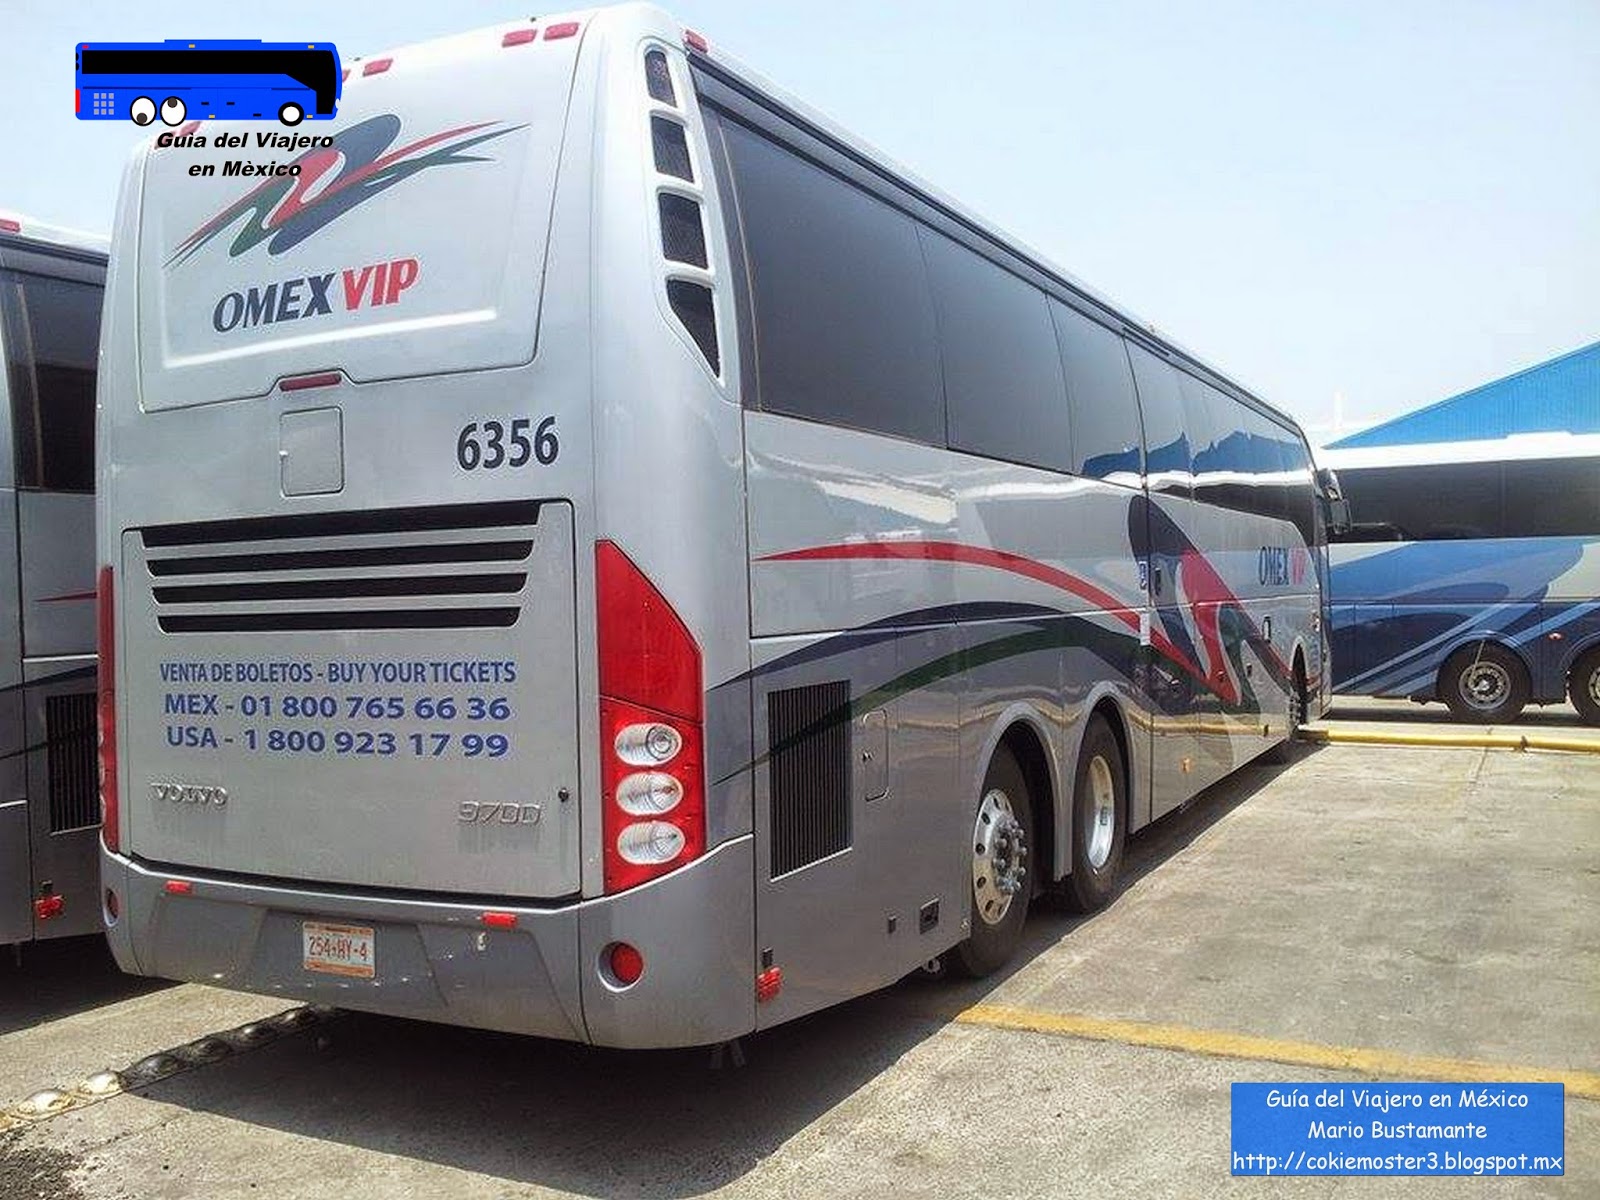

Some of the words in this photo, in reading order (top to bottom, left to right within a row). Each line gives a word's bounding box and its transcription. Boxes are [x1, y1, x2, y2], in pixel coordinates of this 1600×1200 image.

[212, 273, 335, 333] OMEX
[342, 258, 419, 310] VIP
[456, 416, 560, 471] 6356
[1259, 546, 1289, 585] OMEX
[160, 663, 207, 682] VENTA
[211, 663, 232, 682] DE
[236, 663, 312, 682] BOLETOS
[328, 662, 366, 682] BUY
[370, 662, 426, 682] YOUR
[429, 662, 516, 683] TICKETS
[164, 693, 219, 715] MEX
[241, 695, 271, 716] 01
[282, 696, 337, 718] 800
[346, 697, 405, 719] 765
[414, 697, 456, 719] 66
[467, 697, 511, 720] 36
[167, 726, 218, 748] USA
[244, 729, 256, 750] 1
[267, 729, 325, 752] 800
[334, 731, 397, 754] 923
[409, 733, 451, 756] 17
[461, 734, 508, 757] 99
[150, 782, 228, 806] VOLVO
[458, 800, 541, 825] 9700
